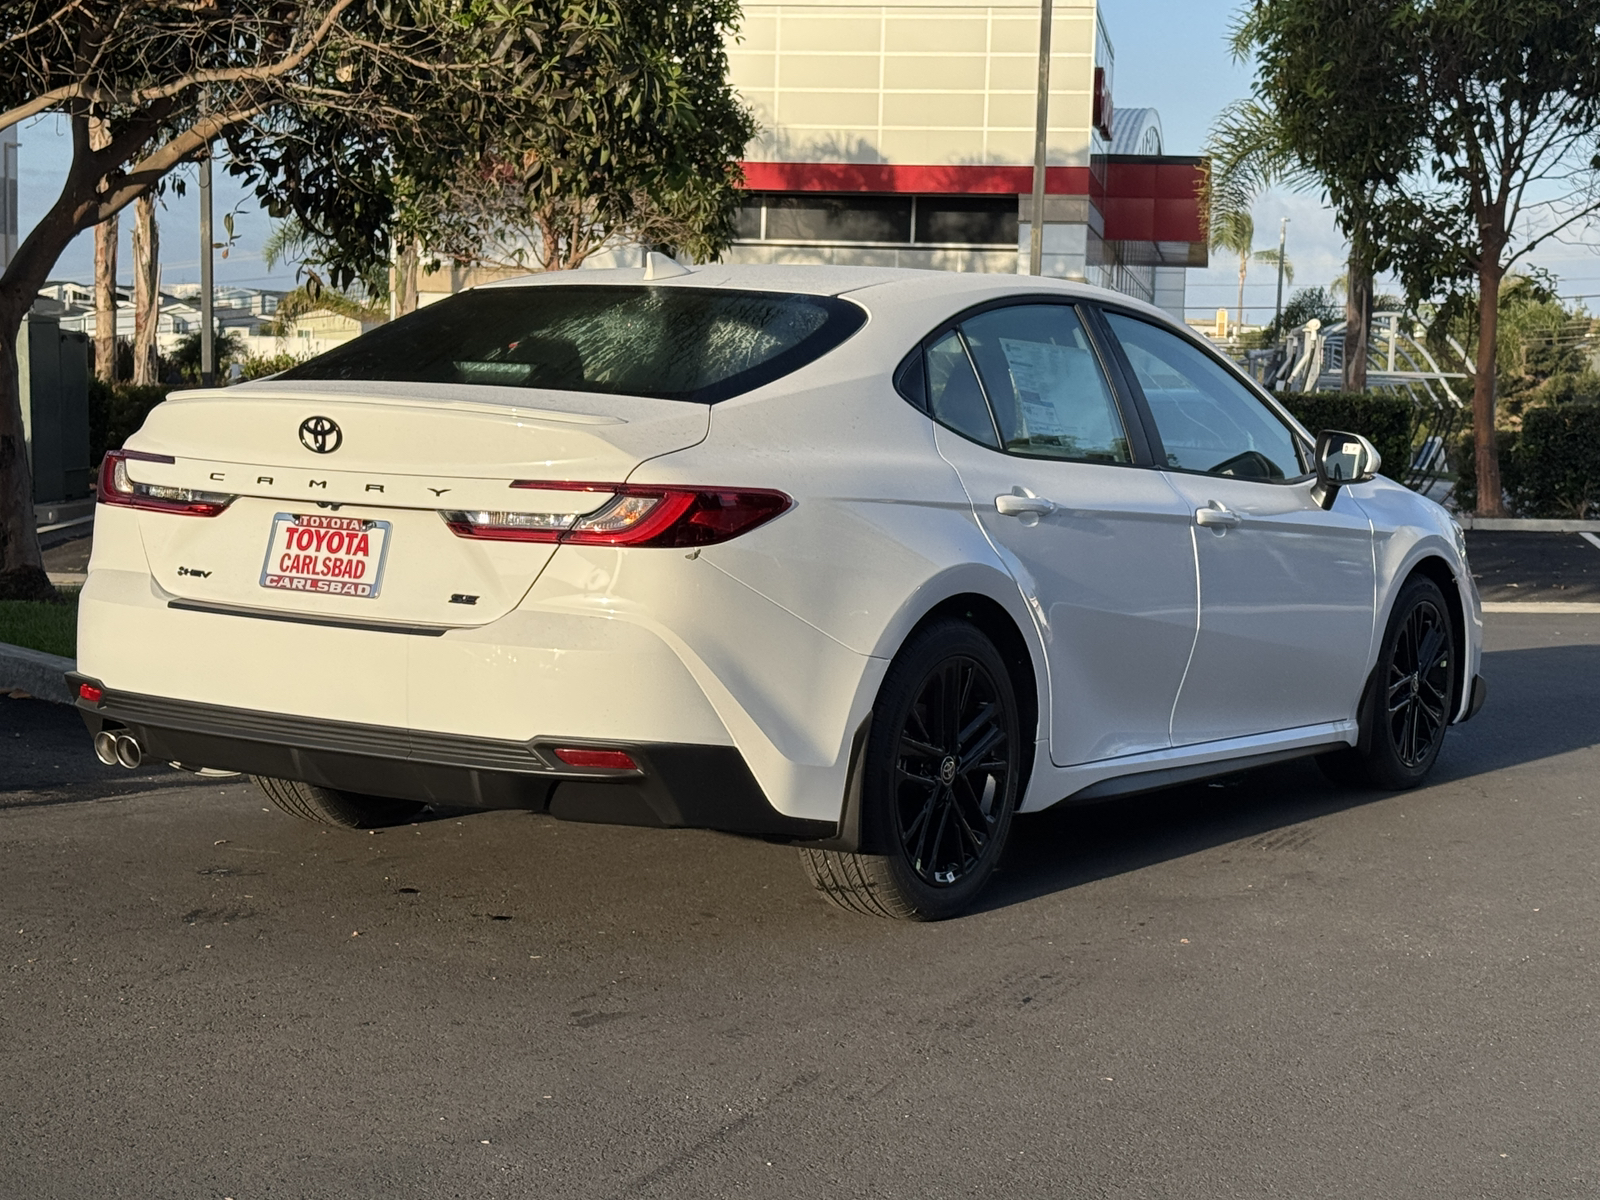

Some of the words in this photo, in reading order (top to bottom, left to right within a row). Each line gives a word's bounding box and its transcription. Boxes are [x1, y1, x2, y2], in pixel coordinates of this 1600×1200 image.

[209, 472, 452, 497] CAMRY
[301, 515, 360, 531] TOYOTA
[286, 527, 369, 557] TOYOTA
[279, 553, 366, 579] CARLSBAD
[265, 575, 371, 596] CARLSBAD
